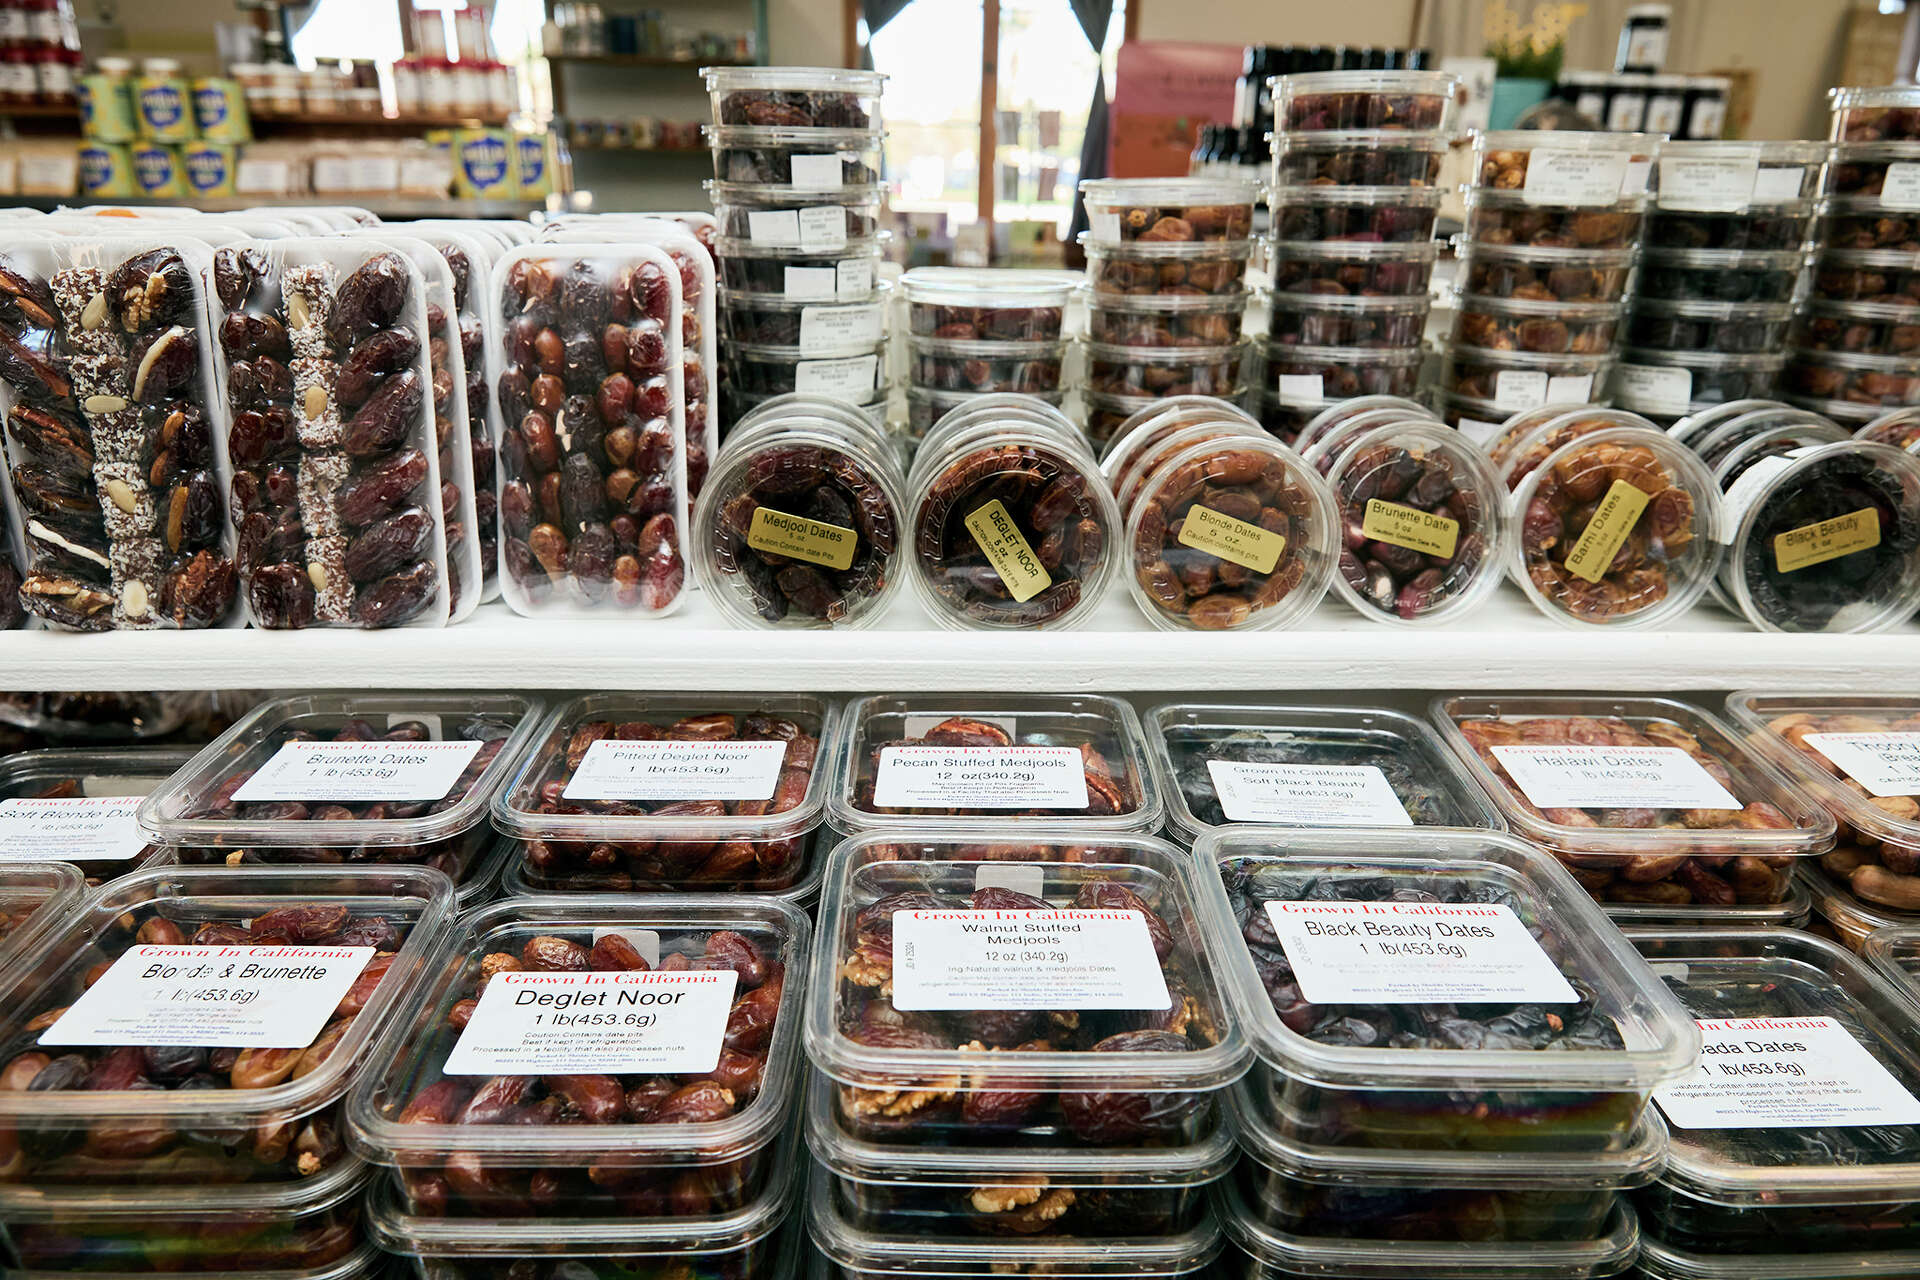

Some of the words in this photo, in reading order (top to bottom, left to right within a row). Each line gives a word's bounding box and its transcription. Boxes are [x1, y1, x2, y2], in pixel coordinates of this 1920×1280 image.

[1372, 501, 1421, 524] Brunette
[1424, 514, 1450, 532] Date
[762, 513, 808, 534] Medjool
[809, 524, 843, 543] Dates
[1199, 511, 1233, 530] Blonde
[1234, 523, 1262, 542] Dates
[1570, 532, 1597, 566] Barhi
[1592, 494, 1621, 531] Dates
[1785, 528, 1818, 547] Black
[1820, 516, 1859, 537] Beauty
[1208, 529, 1218, 538] 5
[989, 510, 1020, 548] DEGLET
[1015, 549, 1039, 579] NOOR
[999, 547, 1009, 558] oz
[384, 742, 470, 751] California
[604, 742, 661, 750] Grown
[668, 742, 685, 750] In
[690, 742, 773, 750] California
[987, 748, 1072, 756] California
[306, 753, 378, 766] Brunette
[379, 753, 429, 766] Dates
[612, 750, 657, 761] Pitted
[660, 751, 708, 763] Deglet
[713, 752, 751, 761] Noor
[1532, 755, 1601, 768] Halawi
[1602, 755, 1664, 768] Dates
[646, 765, 731, 775] lb(453.6g)
[892, 758, 939, 768] Pecan
[943, 757, 996, 768] Stuffed
[1000, 758, 1067, 770] Medjools
[324, 767, 338, 777] lb
[339, 767, 399, 780] (453.6g)
[936, 772, 953, 780] 12
[961, 772, 1036, 782] oz(340.2g)
[1233, 766, 1279, 775] Grown
[1299, 768, 1366, 777] California
[1242, 776, 1271, 785] Soft
[1275, 777, 1313, 786] Black
[1317, 778, 1367, 790] Beauty
[1288, 789, 1354, 800] lb(453.6g)
[0, 810, 38, 819] Soft
[41, 810, 102, 819] Blonde
[106, 810, 137, 818] Dat
[914, 911, 985, 920] Grown
[995, 911, 1018, 920] In
[1026, 911, 1132, 920] California
[1281, 902, 1355, 915] Grown
[1363, 904, 1387, 916] In
[1393, 904, 1500, 918] California
[961, 923, 1018, 933] Walnut
[1024, 923, 1082, 933] Stuffed
[1304, 920, 1361, 937] Black
[1362, 921, 1431, 941] Beauty
[1435, 921, 1496, 939] Dates
[986, 935, 1062, 947] Medjools
[140, 946, 210, 959] Grown
[218, 946, 241, 959] In
[248, 946, 355, 960] California
[1360, 942, 1369, 954] 1
[1379, 941, 1468, 959] lb(453.6g)
[985, 951, 1000, 961] 12
[1003, 953, 1016, 961] oz
[1020, 951, 1070, 963] (340.2g)
[218, 964, 236, 979] &
[240, 964, 328, 980] Brunette
[1089, 964, 1117, 972] Dates
[505, 974, 576, 986] Grown
[585, 974, 606, 985] In
[615, 972, 718, 985] California
[515, 989, 608, 1010] Deglet
[616, 989, 686, 1006] Noor
[534, 1013, 544, 1025] 1
[552, 1013, 658, 1028] lb(453.6g)
[1697, 1020, 1720, 1032] In
[1724, 1018, 1830, 1031] California
[552, 1039, 574, 1047] kept
[1744, 1040, 1807, 1054] Dates
[1701, 1064, 1711, 1076] 1
[1719, 1062, 1807, 1078] lb(453.6g)
